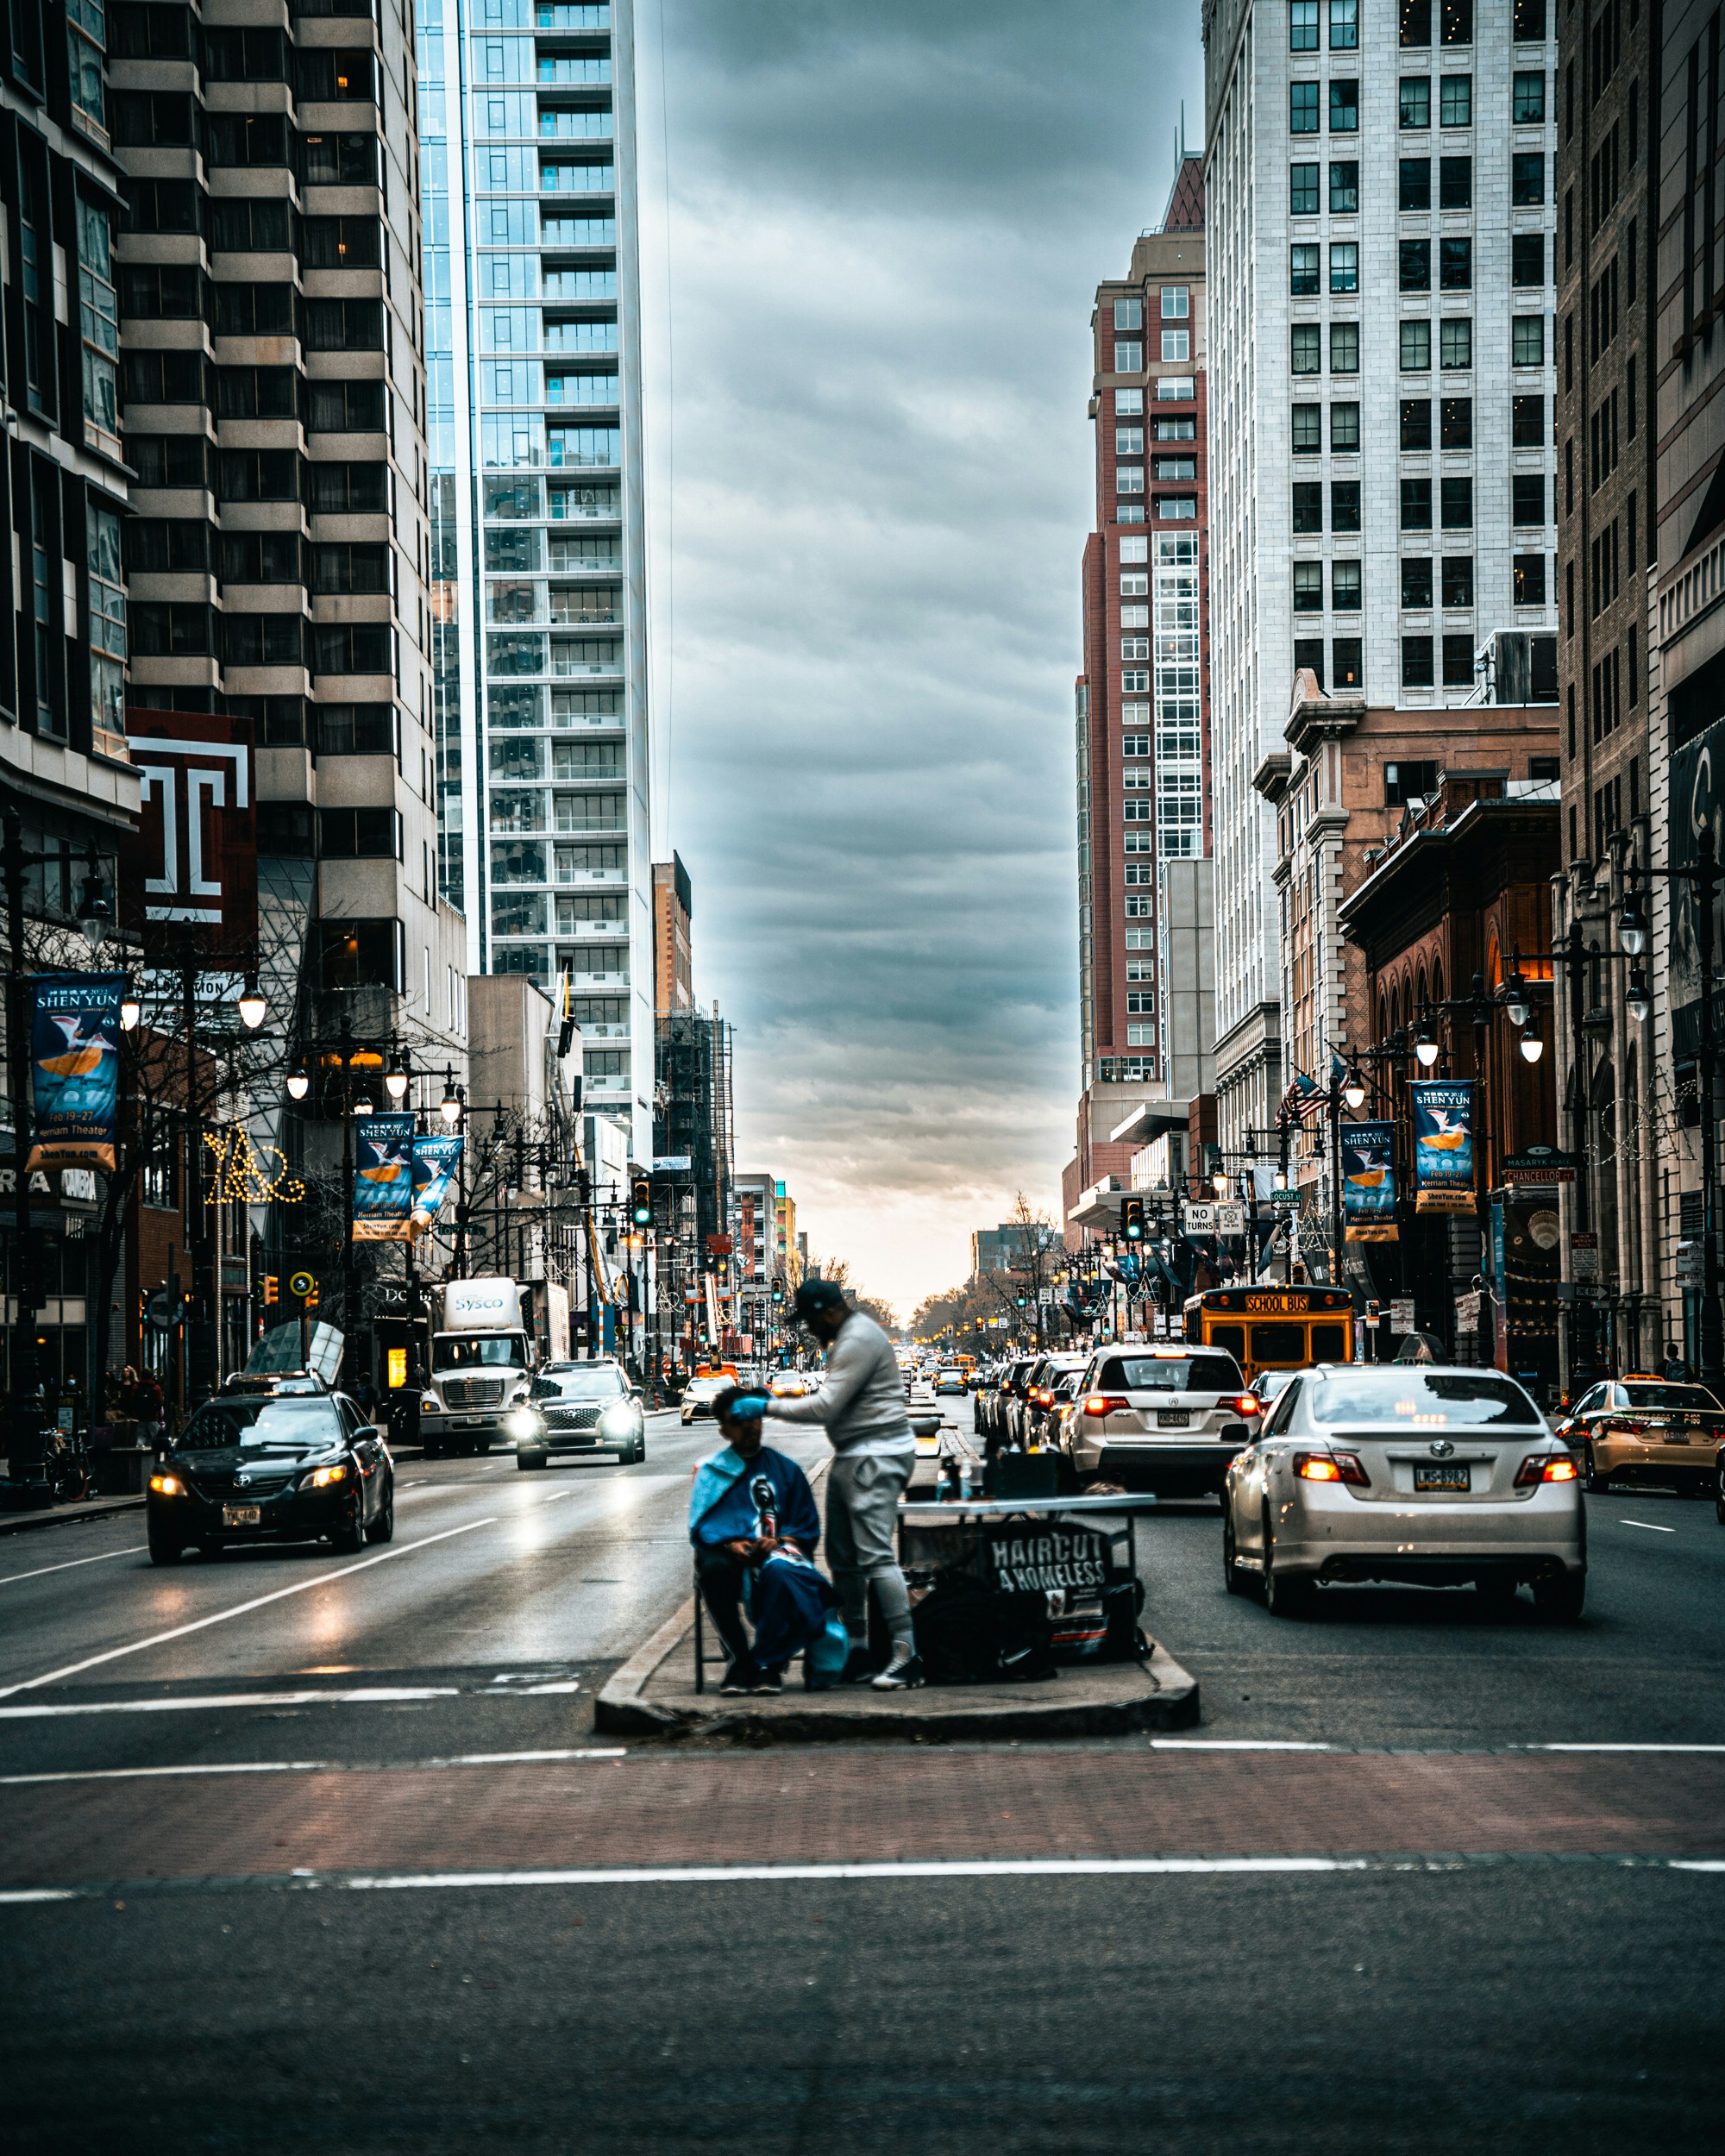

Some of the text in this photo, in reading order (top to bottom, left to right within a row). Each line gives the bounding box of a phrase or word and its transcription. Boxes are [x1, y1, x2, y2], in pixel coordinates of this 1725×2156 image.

[37, 994, 118, 1007] SHEN YUN
[1448, 1096, 1470, 1105] YUN
[49, 1113, 63, 1122] Feb
[72, 1125, 107, 1136] Theater
[1371, 1136, 1390, 1144] YUN
[41, 1150, 98, 1159] ShenYun.com
[415, 1148, 439, 1156] SHEN
[1508, 1171, 1561, 1182] CHANCELLOR
[1192, 1209, 1208, 1219] NO
[1248, 1296, 1308, 1310] SCHOOL BUS
[1418, 1470, 1466, 1482] LMS-8982
[992, 1531, 1102, 1569] HAIRCUT
[998, 1560, 1106, 1594] 4 HOMELESS
